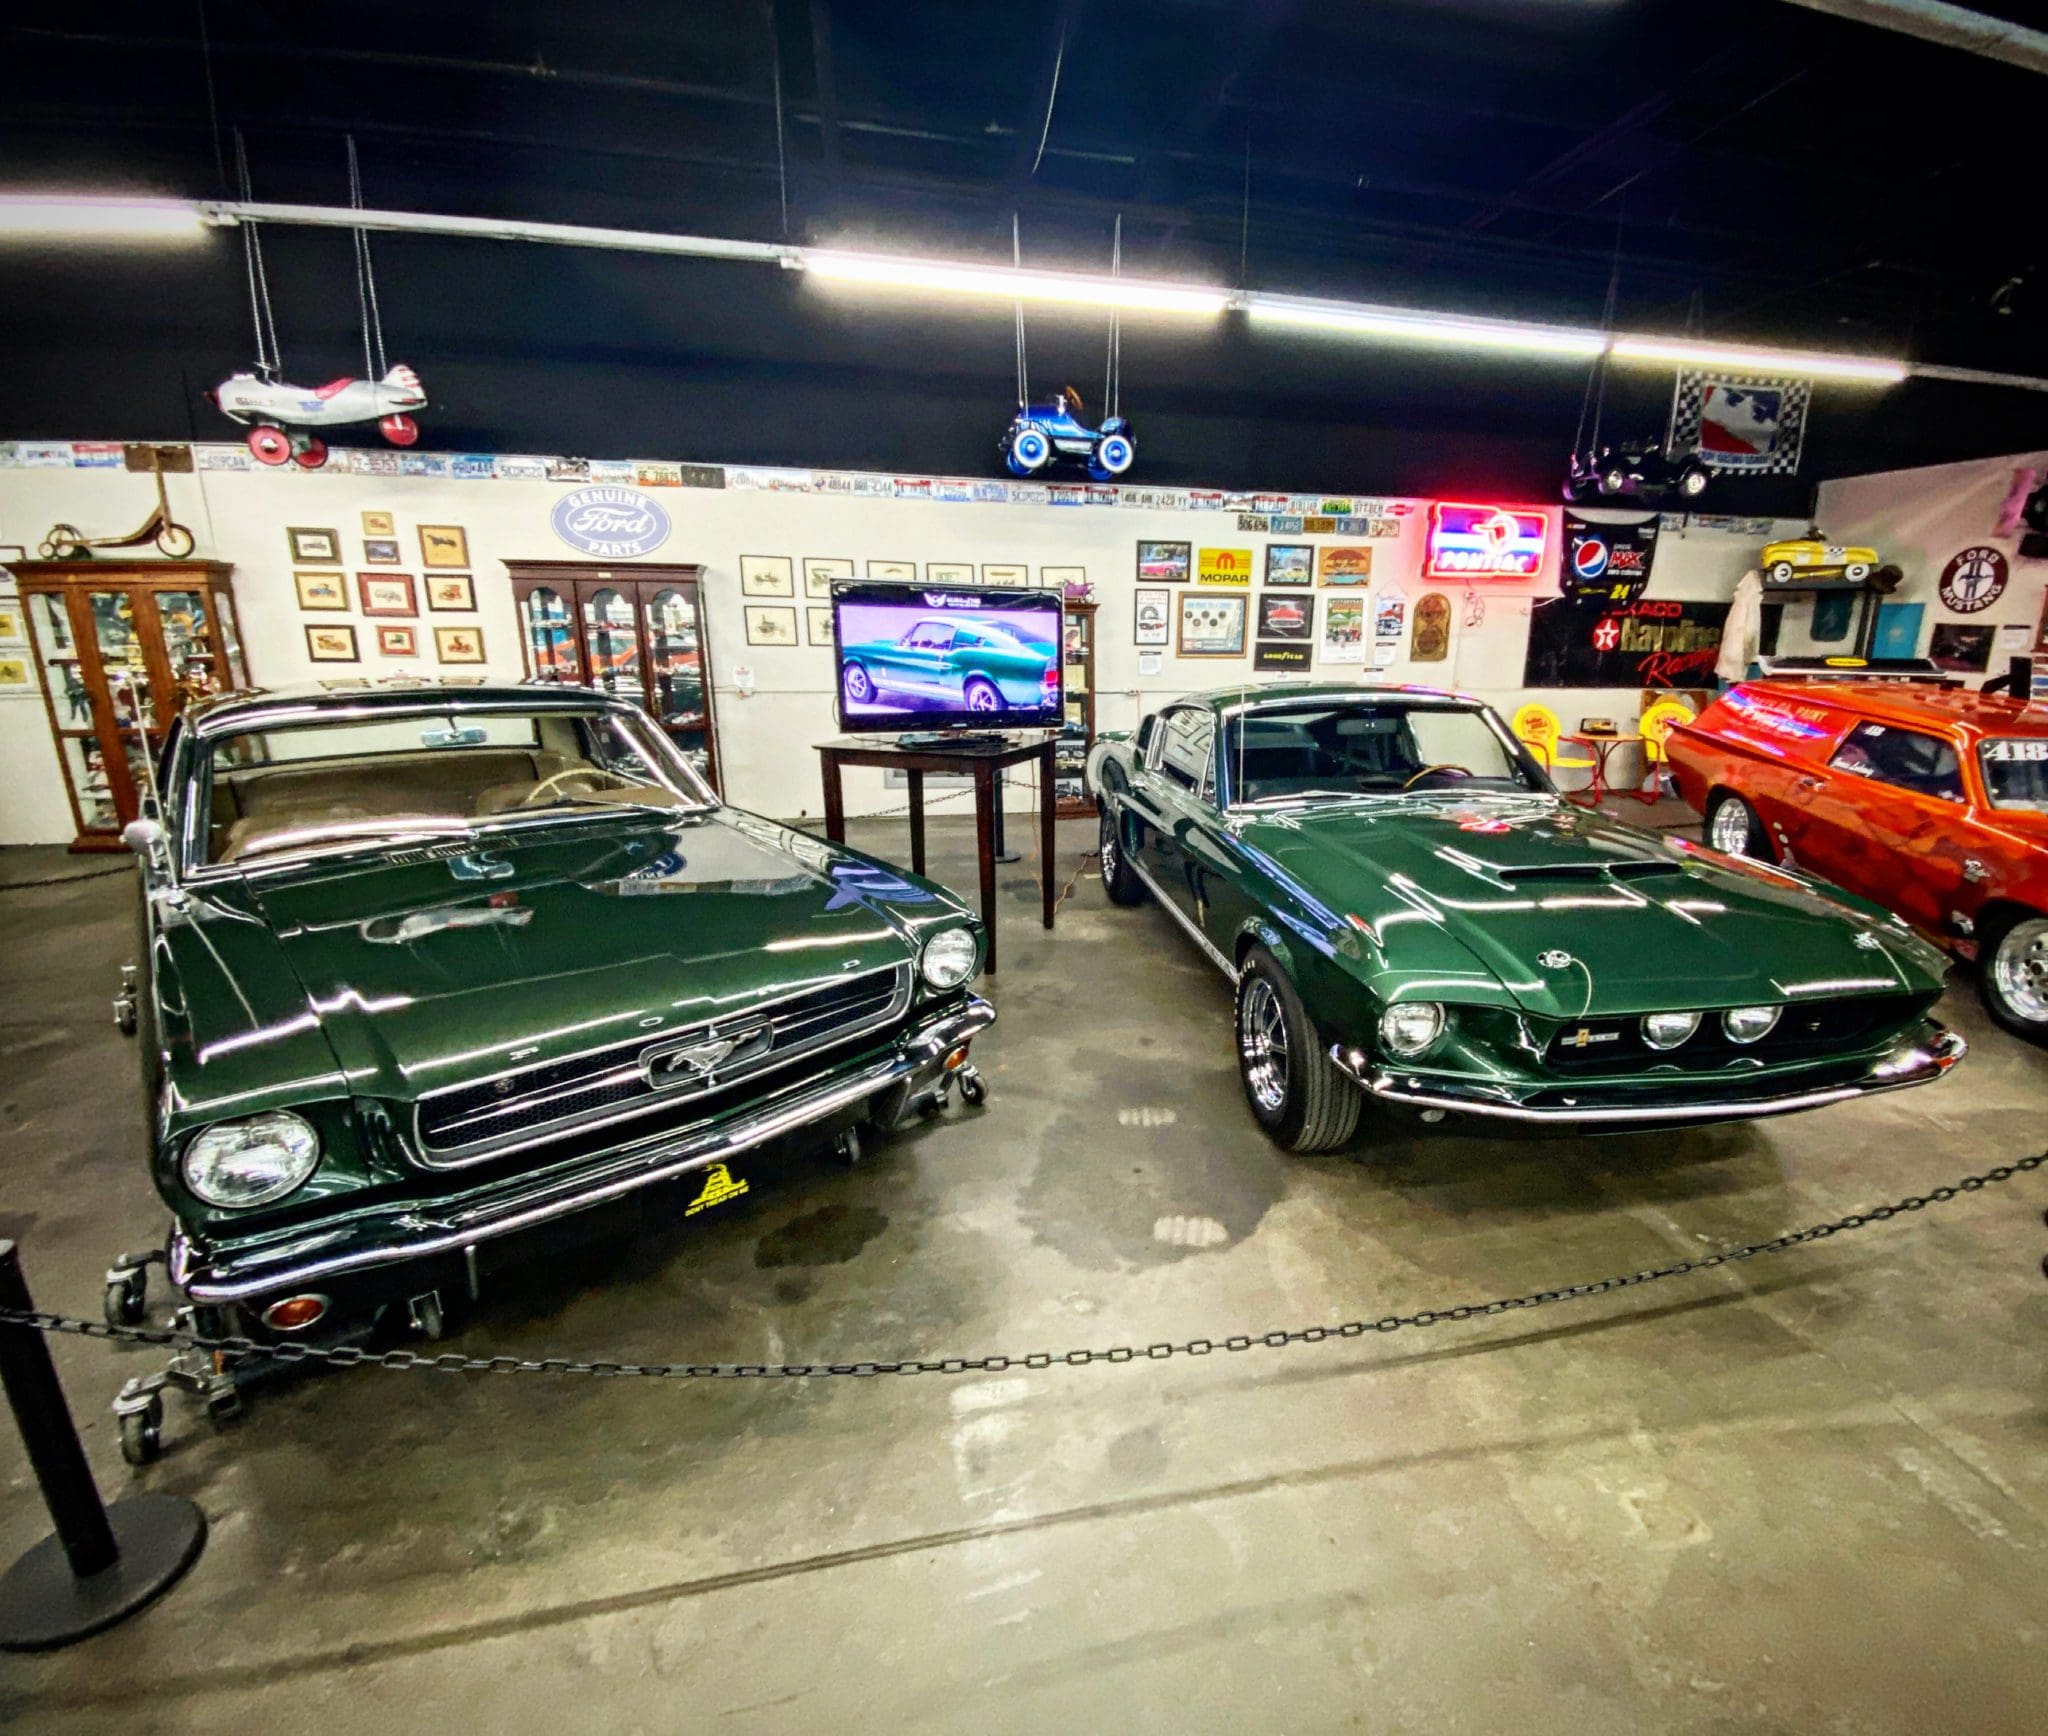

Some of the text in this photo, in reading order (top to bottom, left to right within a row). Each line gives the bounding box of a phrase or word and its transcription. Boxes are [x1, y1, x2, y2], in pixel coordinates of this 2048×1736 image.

[568, 490, 647, 510] GENUINE
[573, 507, 649, 534] Ford
[589, 541, 642, 556] PARTS
[1956, 548, 2000, 566] FORD
[1438, 552, 1530, 573] PONTIAC
[1200, 573, 1249, 583] MOPAR
[1610, 584, 1631, 599] 24
[1941, 584, 2002, 611] MUSTANG
[1602, 601, 1683, 617] XACO
[1620, 617, 1721, 652] Havoline
[1263, 652, 1304, 660] GOODYEAR
[706, 1194, 728, 1208] TREAD
[728, 1190, 739, 1199] ON
[739, 1185, 749, 1194] ME
